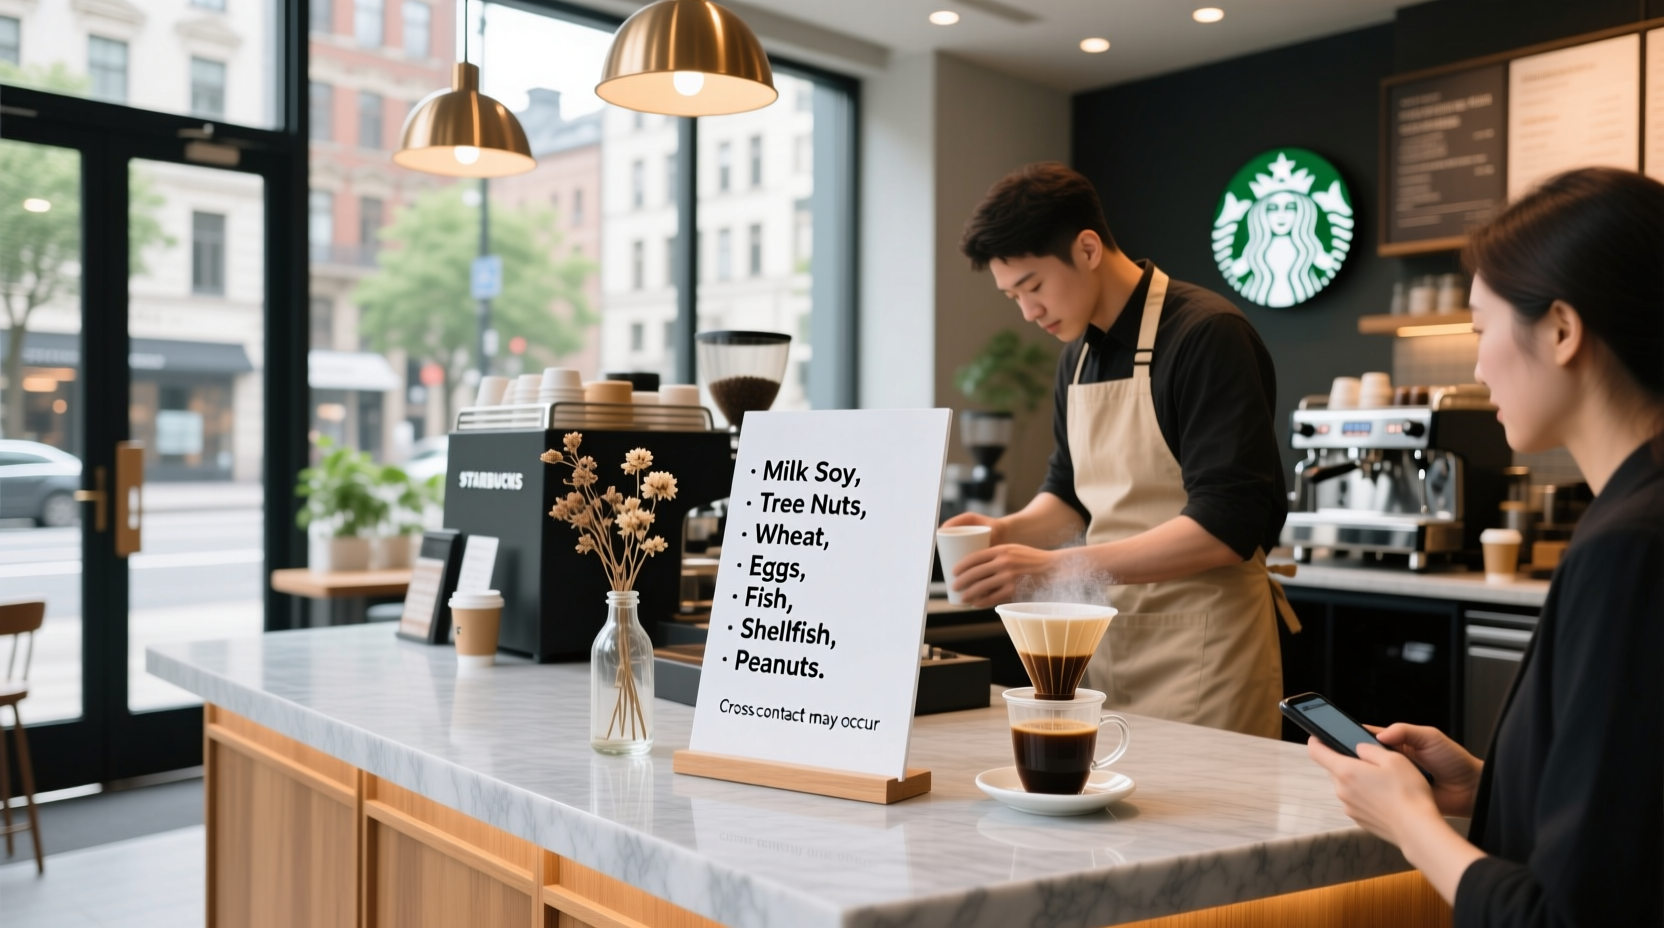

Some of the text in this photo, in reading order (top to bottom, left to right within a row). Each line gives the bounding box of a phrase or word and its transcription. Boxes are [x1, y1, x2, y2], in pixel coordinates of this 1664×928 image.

[459, 471, 523, 490] STARBUCKS
[763, 460, 861, 488] Milk Soy,
[760, 492, 867, 520] Tree Nuts,
[756, 523, 829, 551] Wheat,
[749, 554, 805, 583] Eggs,
[745, 586, 793, 614] Fish,
[740, 617, 836, 650] Shellfish,
[735, 649, 824, 679] Peanuts.
[809, 713, 839, 731] may
[840, 716, 881, 731] occur
